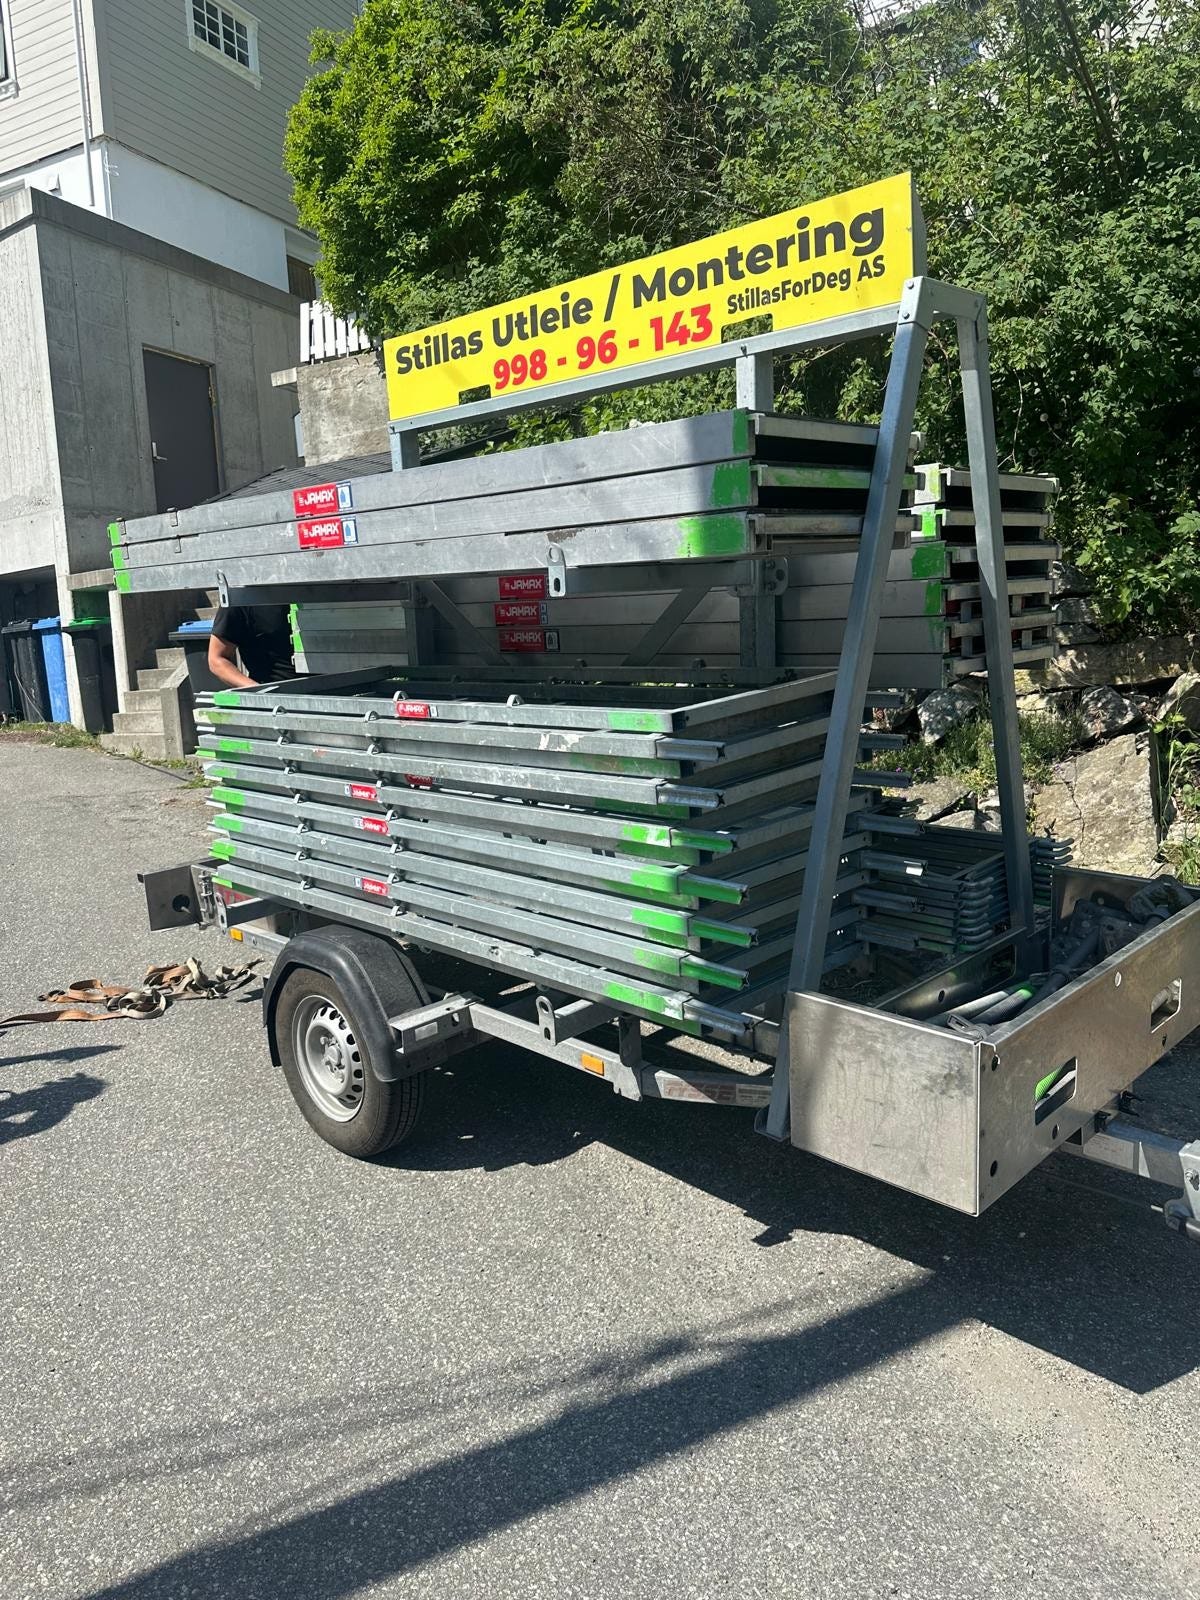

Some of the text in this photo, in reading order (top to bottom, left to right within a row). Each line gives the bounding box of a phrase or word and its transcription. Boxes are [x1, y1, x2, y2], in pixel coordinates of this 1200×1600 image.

[396, 207, 884, 374] Stillas Utleie / Montering
[727, 254, 885, 315] StillasForDeg AS
[493, 303, 713, 390] 998 - 96 - 143
[304, 488, 334, 505] JAMAX
[309, 522, 339, 536] JAMAX
[510, 578, 542, 590] JAMAX
[506, 605, 537, 617] JAMAX
[510, 631, 542, 643] JAMAX
